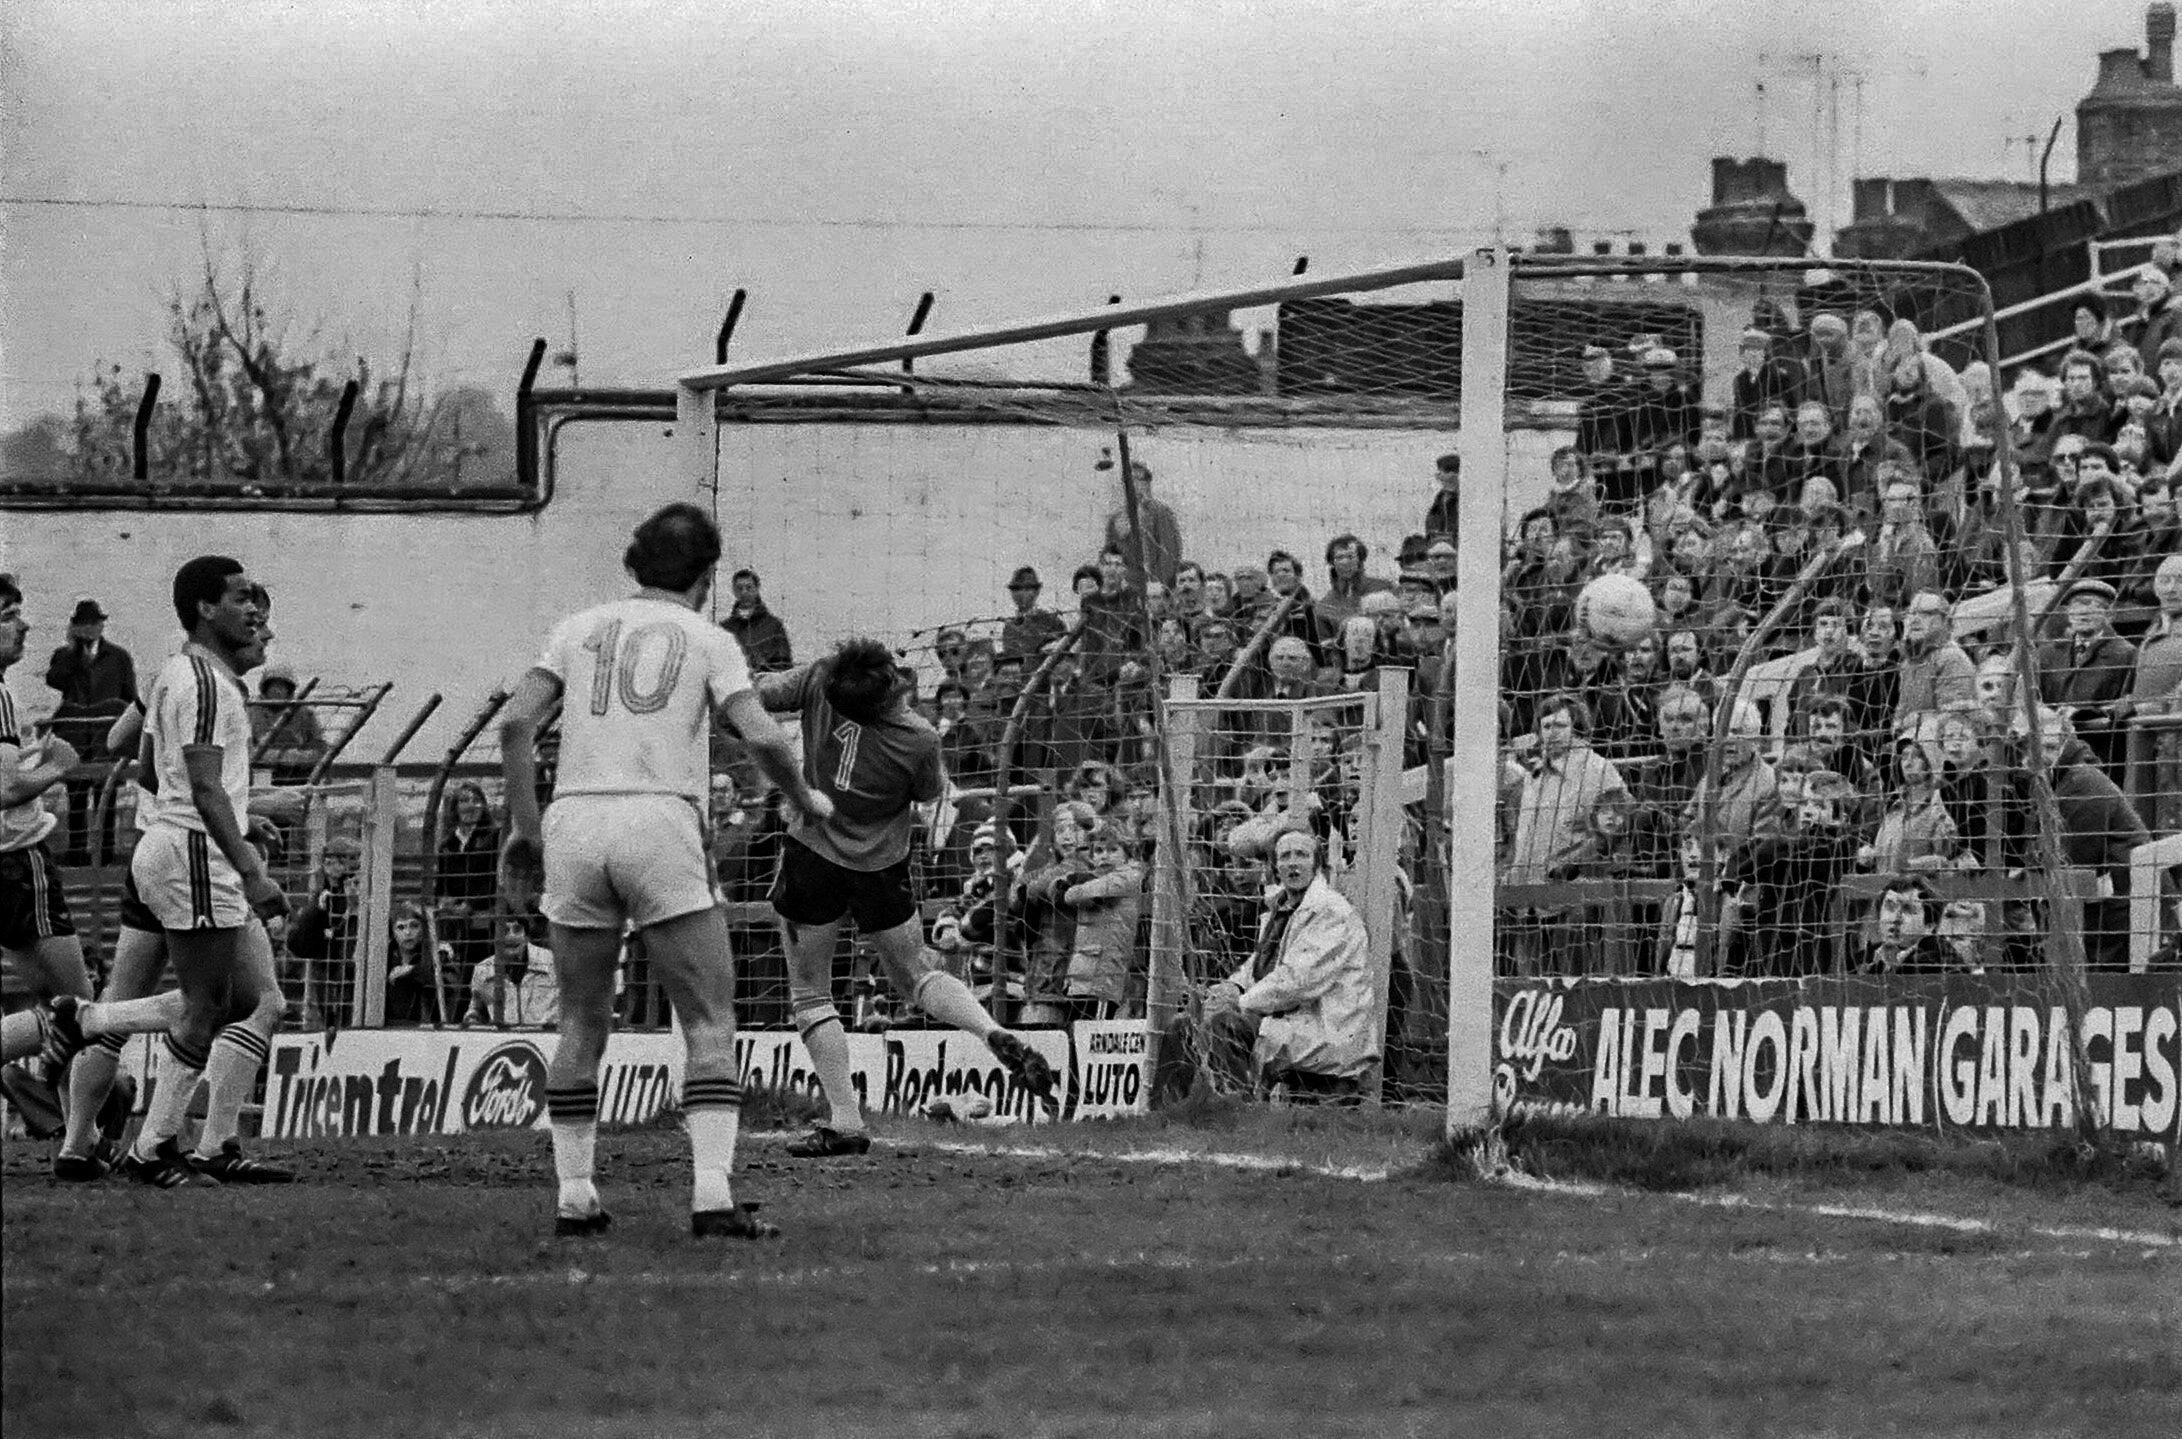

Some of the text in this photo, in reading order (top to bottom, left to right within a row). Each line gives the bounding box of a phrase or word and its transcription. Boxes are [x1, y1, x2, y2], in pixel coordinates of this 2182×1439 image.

[584, 616, 687, 717] 10
[833, 720, 862, 791] 1
[273, 1045, 461, 1136] Tricentrol
[1083, 1063, 1140, 1106] LUTO
[1592, 1008, 1700, 1121] ALEC
[1708, 1006, 1926, 1125] NORMAN
[1941, 1005, 2178, 1134] GARAGES
